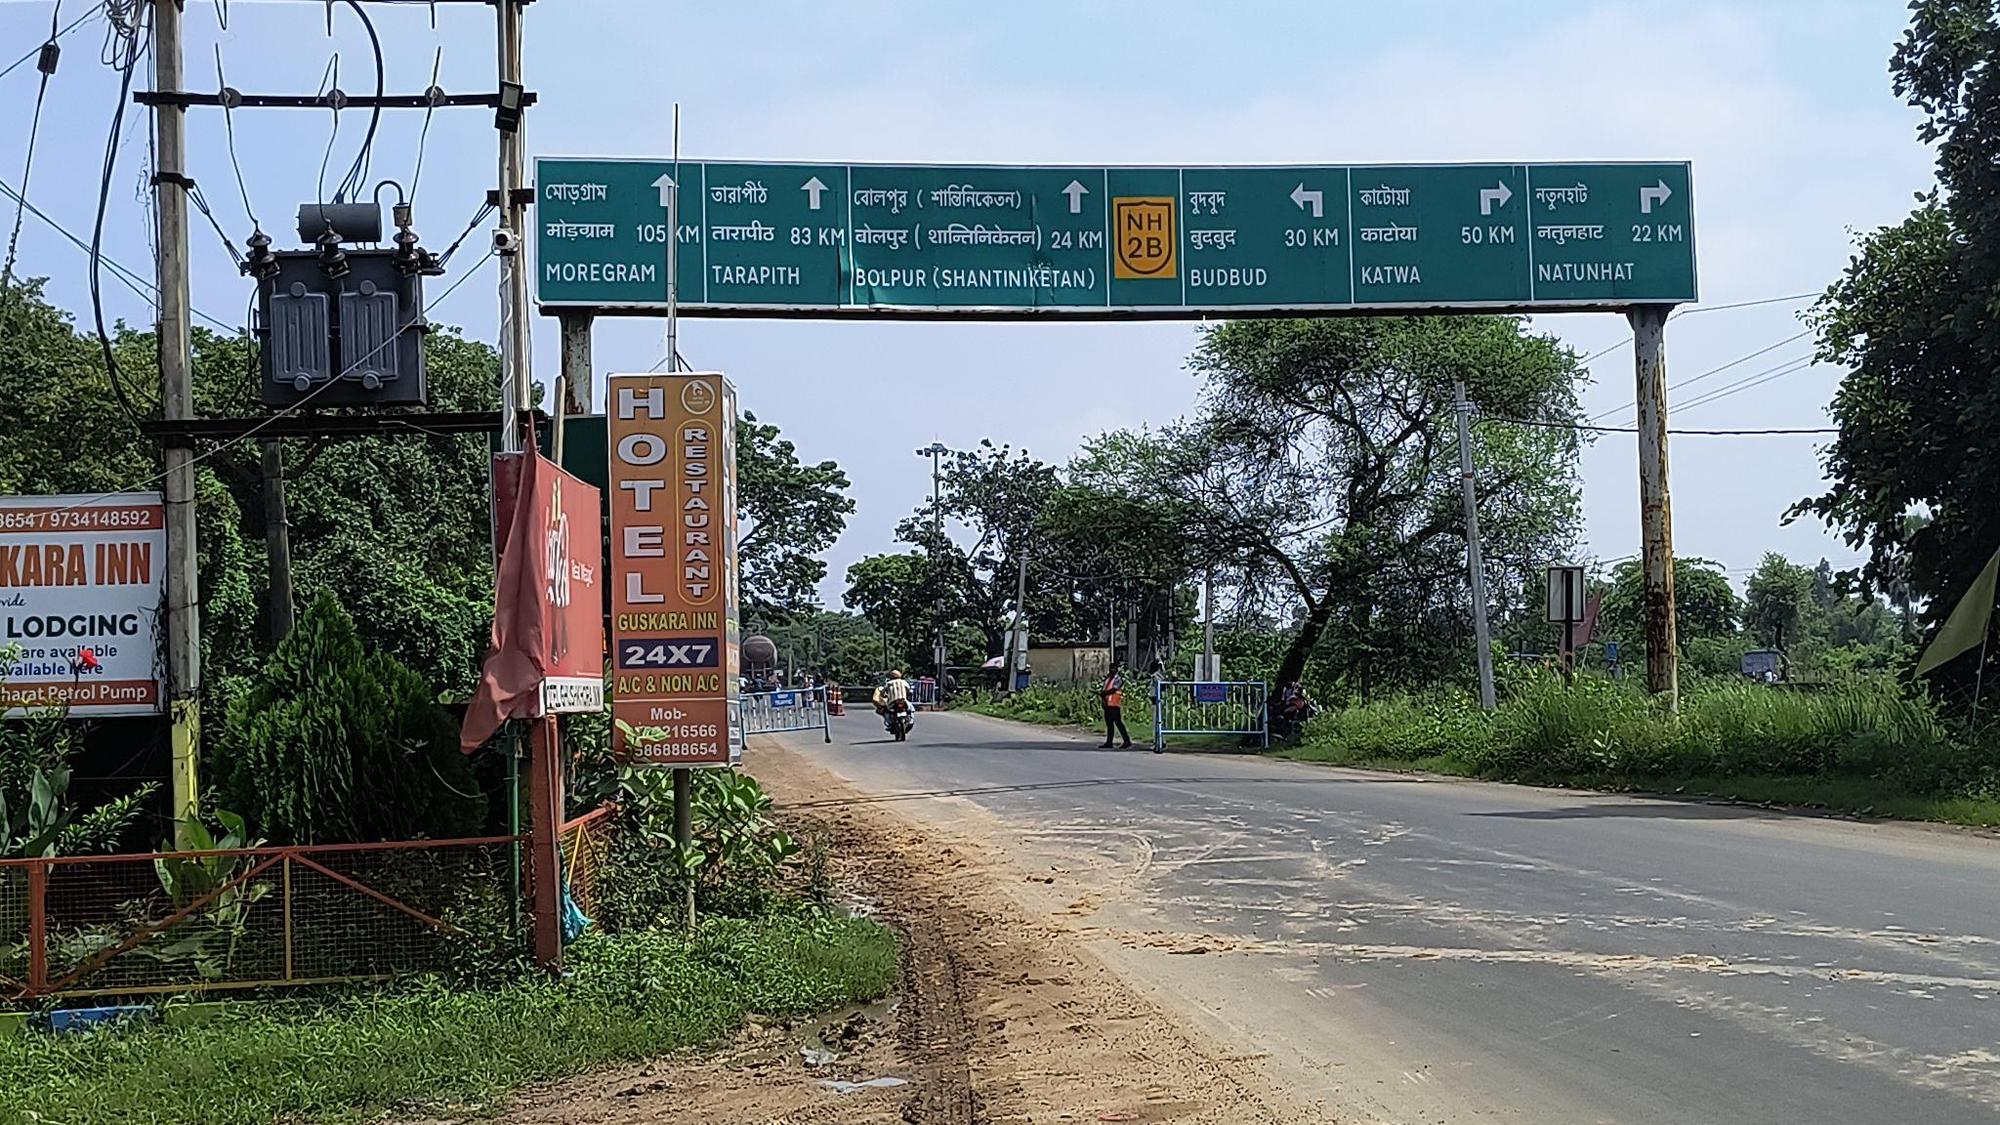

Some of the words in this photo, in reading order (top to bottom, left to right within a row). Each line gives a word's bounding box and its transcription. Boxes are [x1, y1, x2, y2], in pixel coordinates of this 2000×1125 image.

[710, 180, 768, 204] তারাপীঠ
[711, 220, 775, 241] तारापीठ
[1128, 212, 1162, 230] NH
[636, 224, 666, 243] 105
[676, 225, 700, 244] KM
[790, 227, 812, 245] 83
[819, 228, 846, 247] KM
[854, 224, 908, 250] बोलपुर
[1051, 232, 1072, 249] 24
[1079, 231, 1102, 249] KM
[1190, 230, 1236, 250] बुदबुद
[1284, 229, 1306, 247] 30
[1313, 228, 1338, 246] KM
[1360, 222, 1418, 242] काटोया
[1461, 226, 1482, 244] 50
[1489, 226, 1514, 244] KM
[1537, 225, 1604, 245] नतुनहाट
[1632, 224, 1652, 242] 22
[1658, 224, 1682, 242] KM
[1128, 237, 1162, 258] 2B
[546, 263, 656, 283] MOREGRAM
[712, 265, 800, 285] TARAPITH
[856, 268, 926, 288] BOLPUR
[932, 266, 1096, 290] (SHANTINIKETAN)
[1190, 268, 1268, 286] BUDBUD
[1361, 266, 1421, 285] KATWA
[1538, 262, 1634, 282] NATUNHAT
[617, 387, 668, 604] HOTEL
[50, 510, 150, 527] 9734148592
[683, 428, 709, 598] RESTAURANT
[0, 544, 88, 587] KARA
[96, 542, 151, 585] INN
[7, 614, 138, 638] LODGING
[618, 612, 688, 632] GUSKARA
[692, 612, 718, 630] INN
[22, 648, 45, 659] are
[50, 645, 118, 658] avaible
[625, 644, 712, 666] 24X7
[48, 685, 96, 702] Petrol
[100, 684, 147, 701] Pump
[646, 675, 656, 693] &
[661, 675, 692, 692] NON
[650, 708, 687, 720] Mob-
